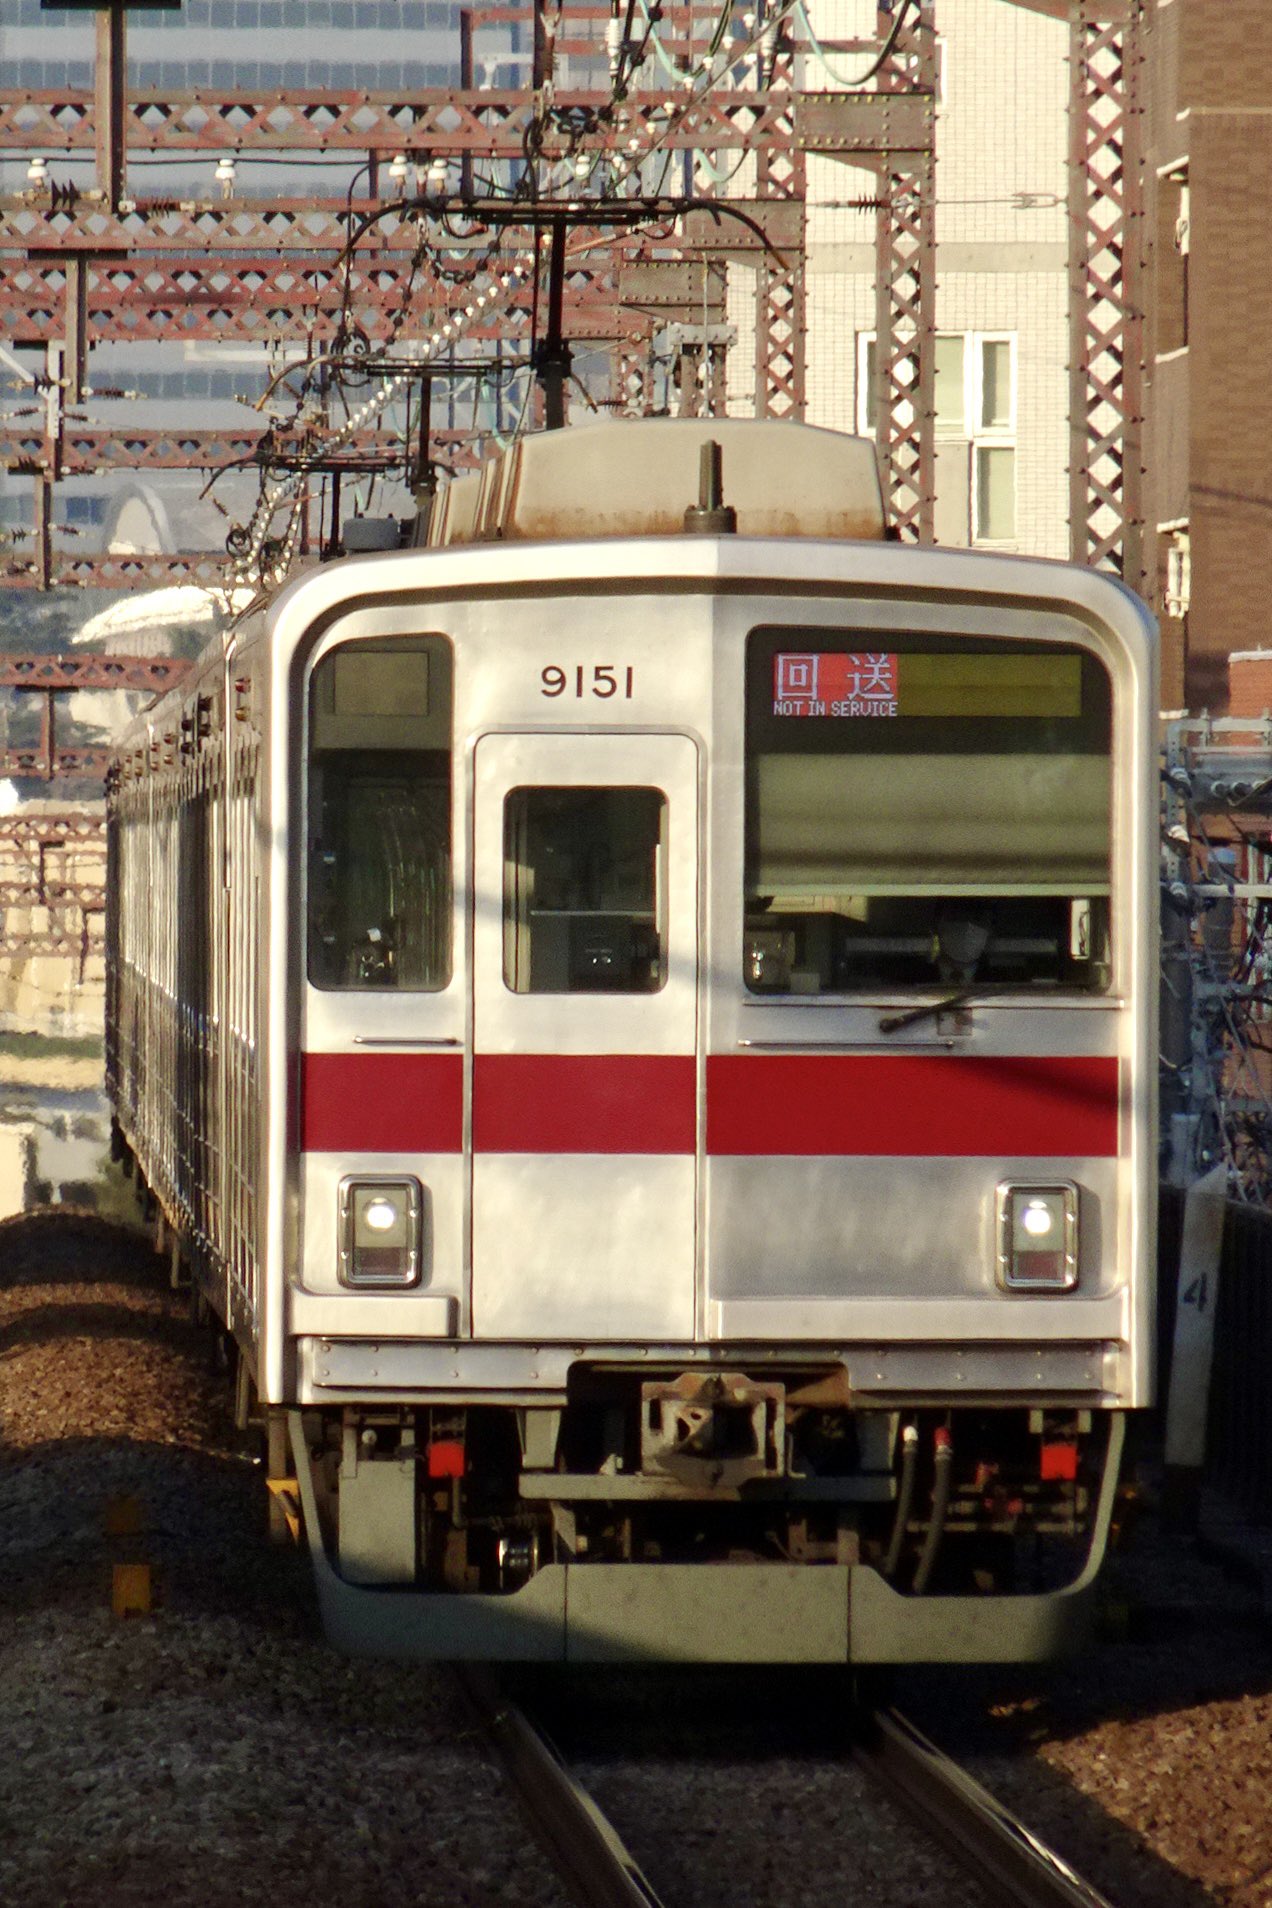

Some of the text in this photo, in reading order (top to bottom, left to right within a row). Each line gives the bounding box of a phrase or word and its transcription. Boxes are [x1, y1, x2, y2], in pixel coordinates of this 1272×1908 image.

[541, 665, 633, 699] 9151
[777, 653, 895, 701] 回送
[774, 701, 899, 717] NOT IN SERVICE
[1183, 1272, 1208, 1313] 4
